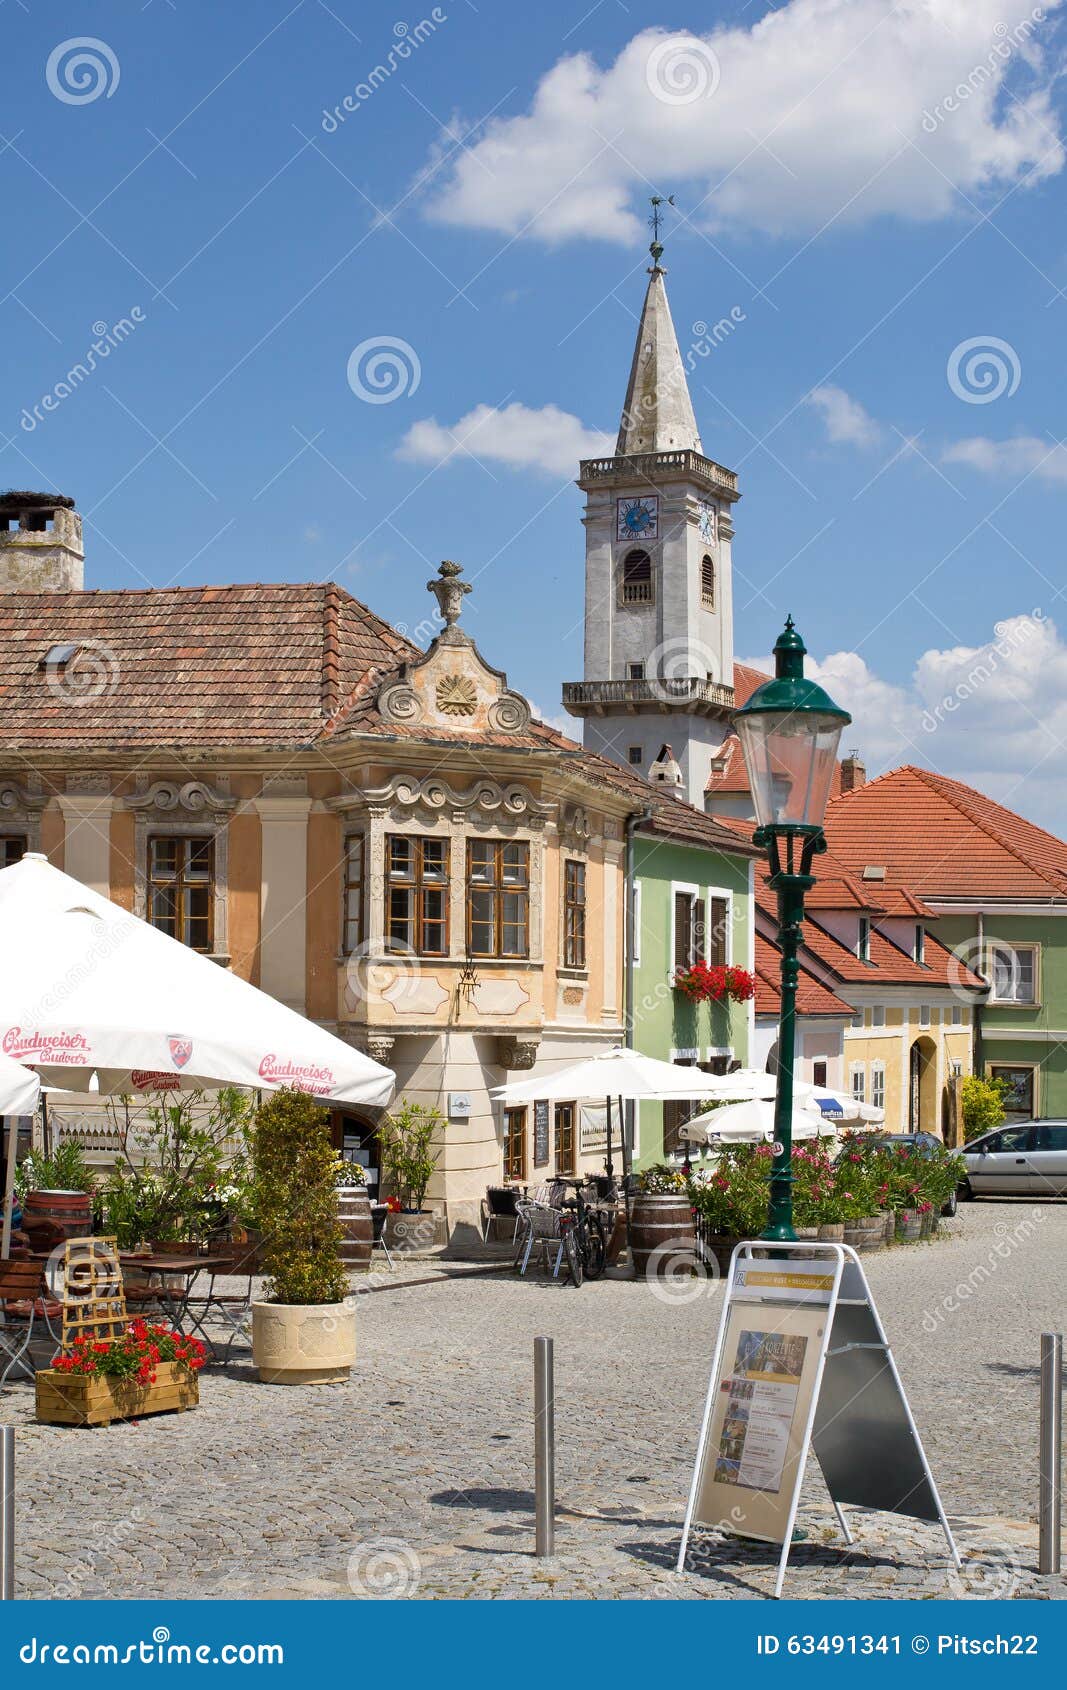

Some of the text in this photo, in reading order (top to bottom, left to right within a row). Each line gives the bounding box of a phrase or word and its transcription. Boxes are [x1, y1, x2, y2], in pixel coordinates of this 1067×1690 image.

[2, 1026, 91, 1053] Budweiser
[40, 1047, 88, 1064] Budvar
[258, 1054, 336, 1082] Budweiser
